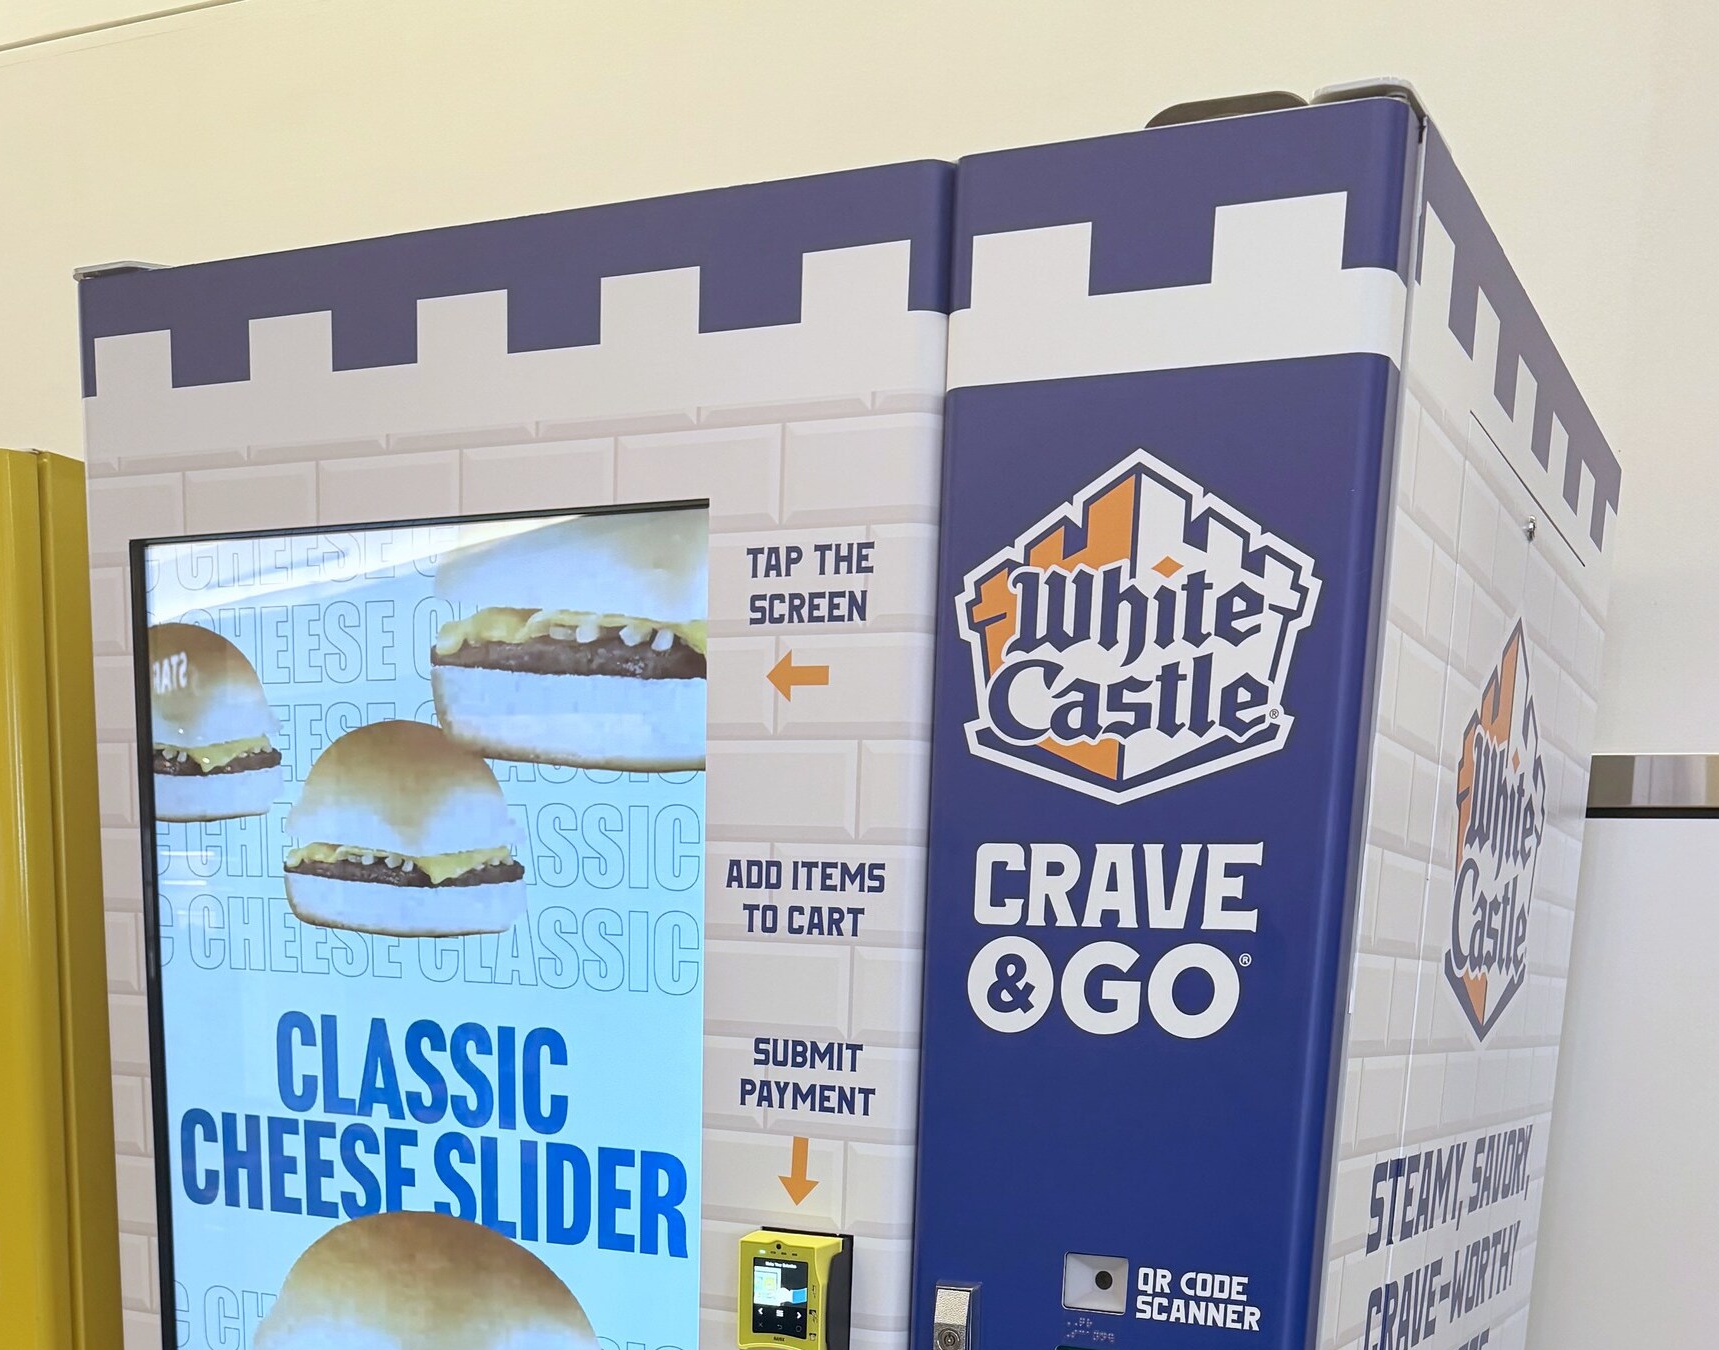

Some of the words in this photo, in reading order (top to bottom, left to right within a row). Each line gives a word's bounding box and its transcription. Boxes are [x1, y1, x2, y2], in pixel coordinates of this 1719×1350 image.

[746, 545, 803, 578] TAP
[814, 541, 876, 576] THE
[749, 590, 868, 626] SCREEN
[1007, 555, 1267, 667] White
[987, 656, 1271, 742] Castle
[1465, 732, 1535, 880] White
[726, 859, 783, 890] ADD
[792, 860, 886, 894] ITEMS
[974, 842, 1264, 932] CRAVE
[743, 903, 779, 934] TO
[787, 905, 866, 937] CART
[1451, 858, 1529, 976] Castle
[276, 1011, 568, 1135] CLASSIC
[753, 1037, 863, 1074] SUBMIT
[739, 1079, 876, 1117] PAYMENT
[180, 1108, 418, 1221] CHEESE
[433, 1132, 689, 1259] SLIDER
[1366, 1141, 1468, 1256] STEAMY,
[1467, 1124, 1533, 1211] SAVORY,
[1135, 1295, 1261, 1331] SCANNER
[1137, 1267, 1172, 1294] QR
[1181, 1272, 1249, 1301] CODE
